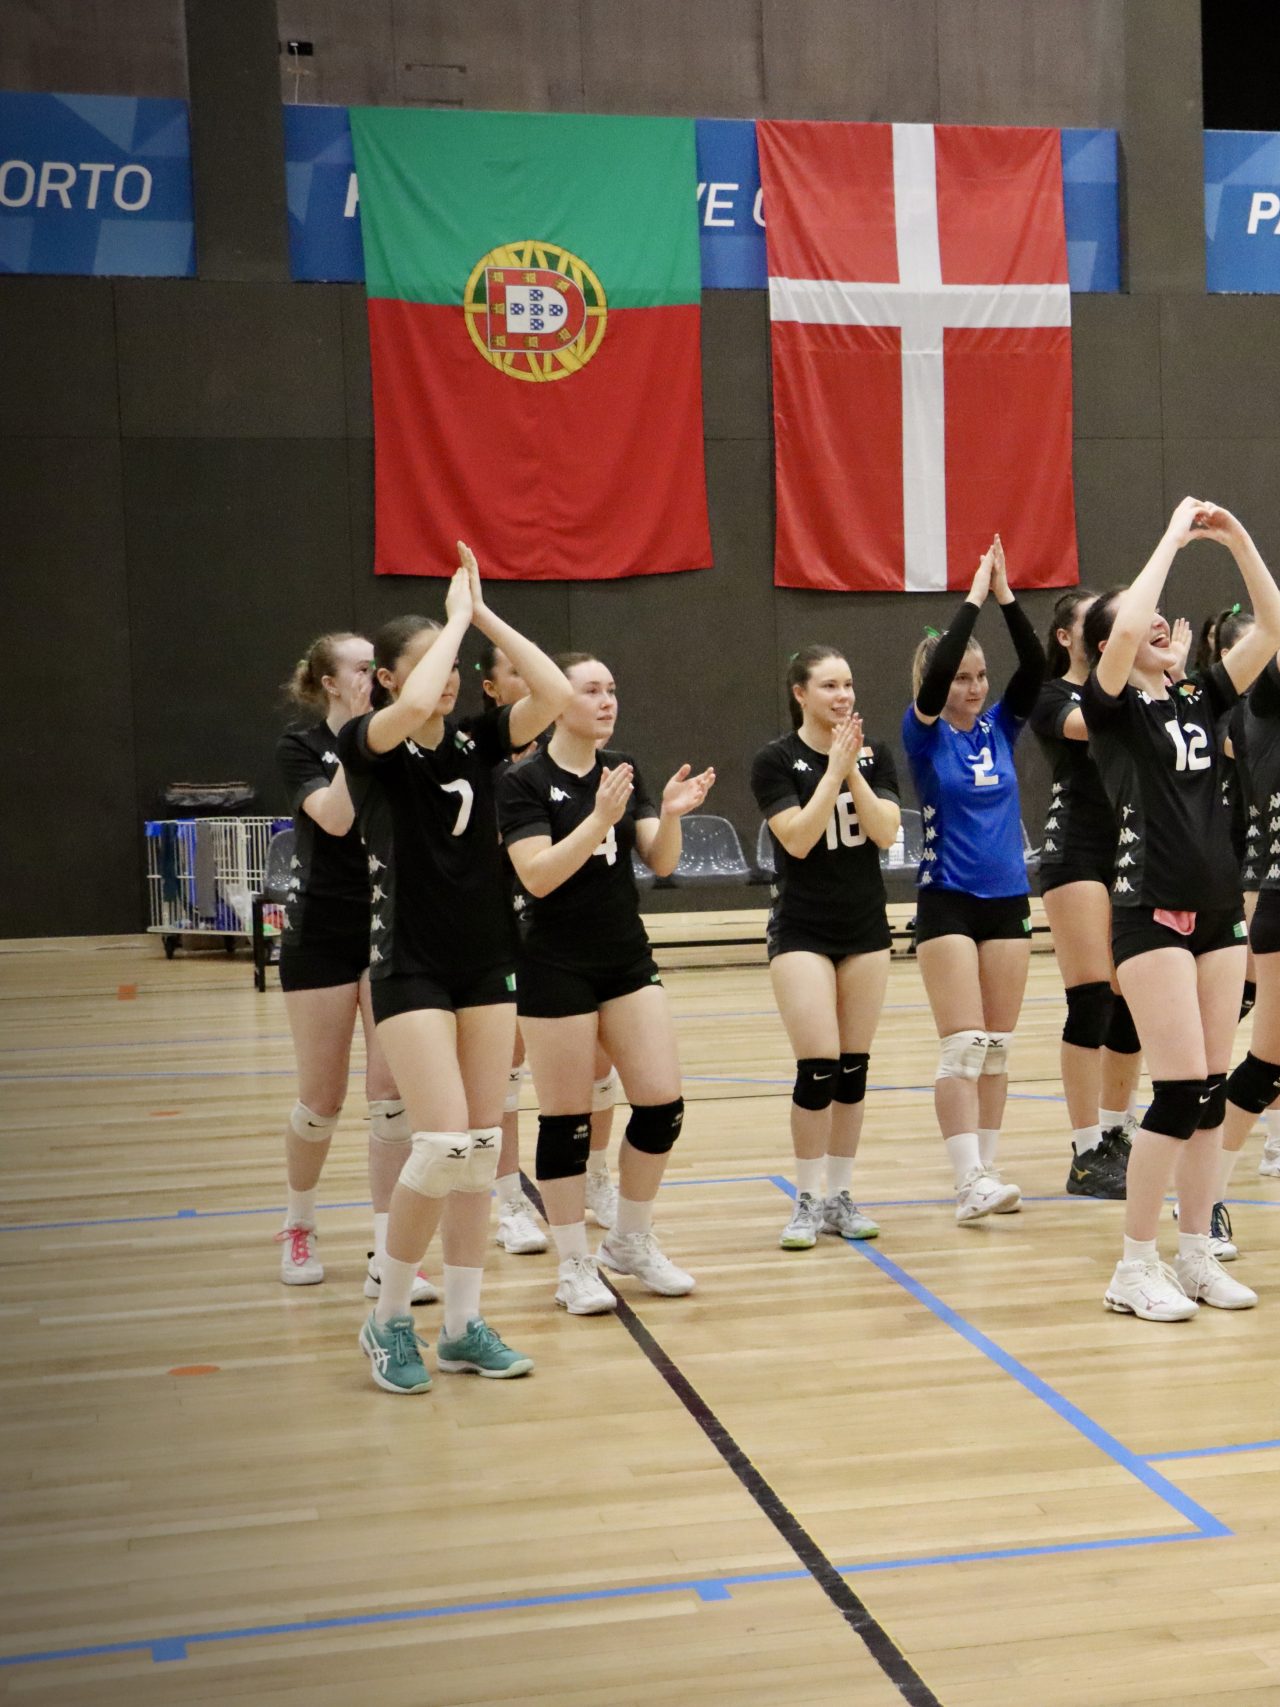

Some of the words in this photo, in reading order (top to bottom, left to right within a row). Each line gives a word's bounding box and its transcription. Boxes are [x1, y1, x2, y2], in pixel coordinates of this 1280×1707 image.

[0, 159, 153, 212] ORTO
[967, 746, 999, 787] 2
[1164, 719, 1211, 771] 12
[440, 778, 474, 837] 7
